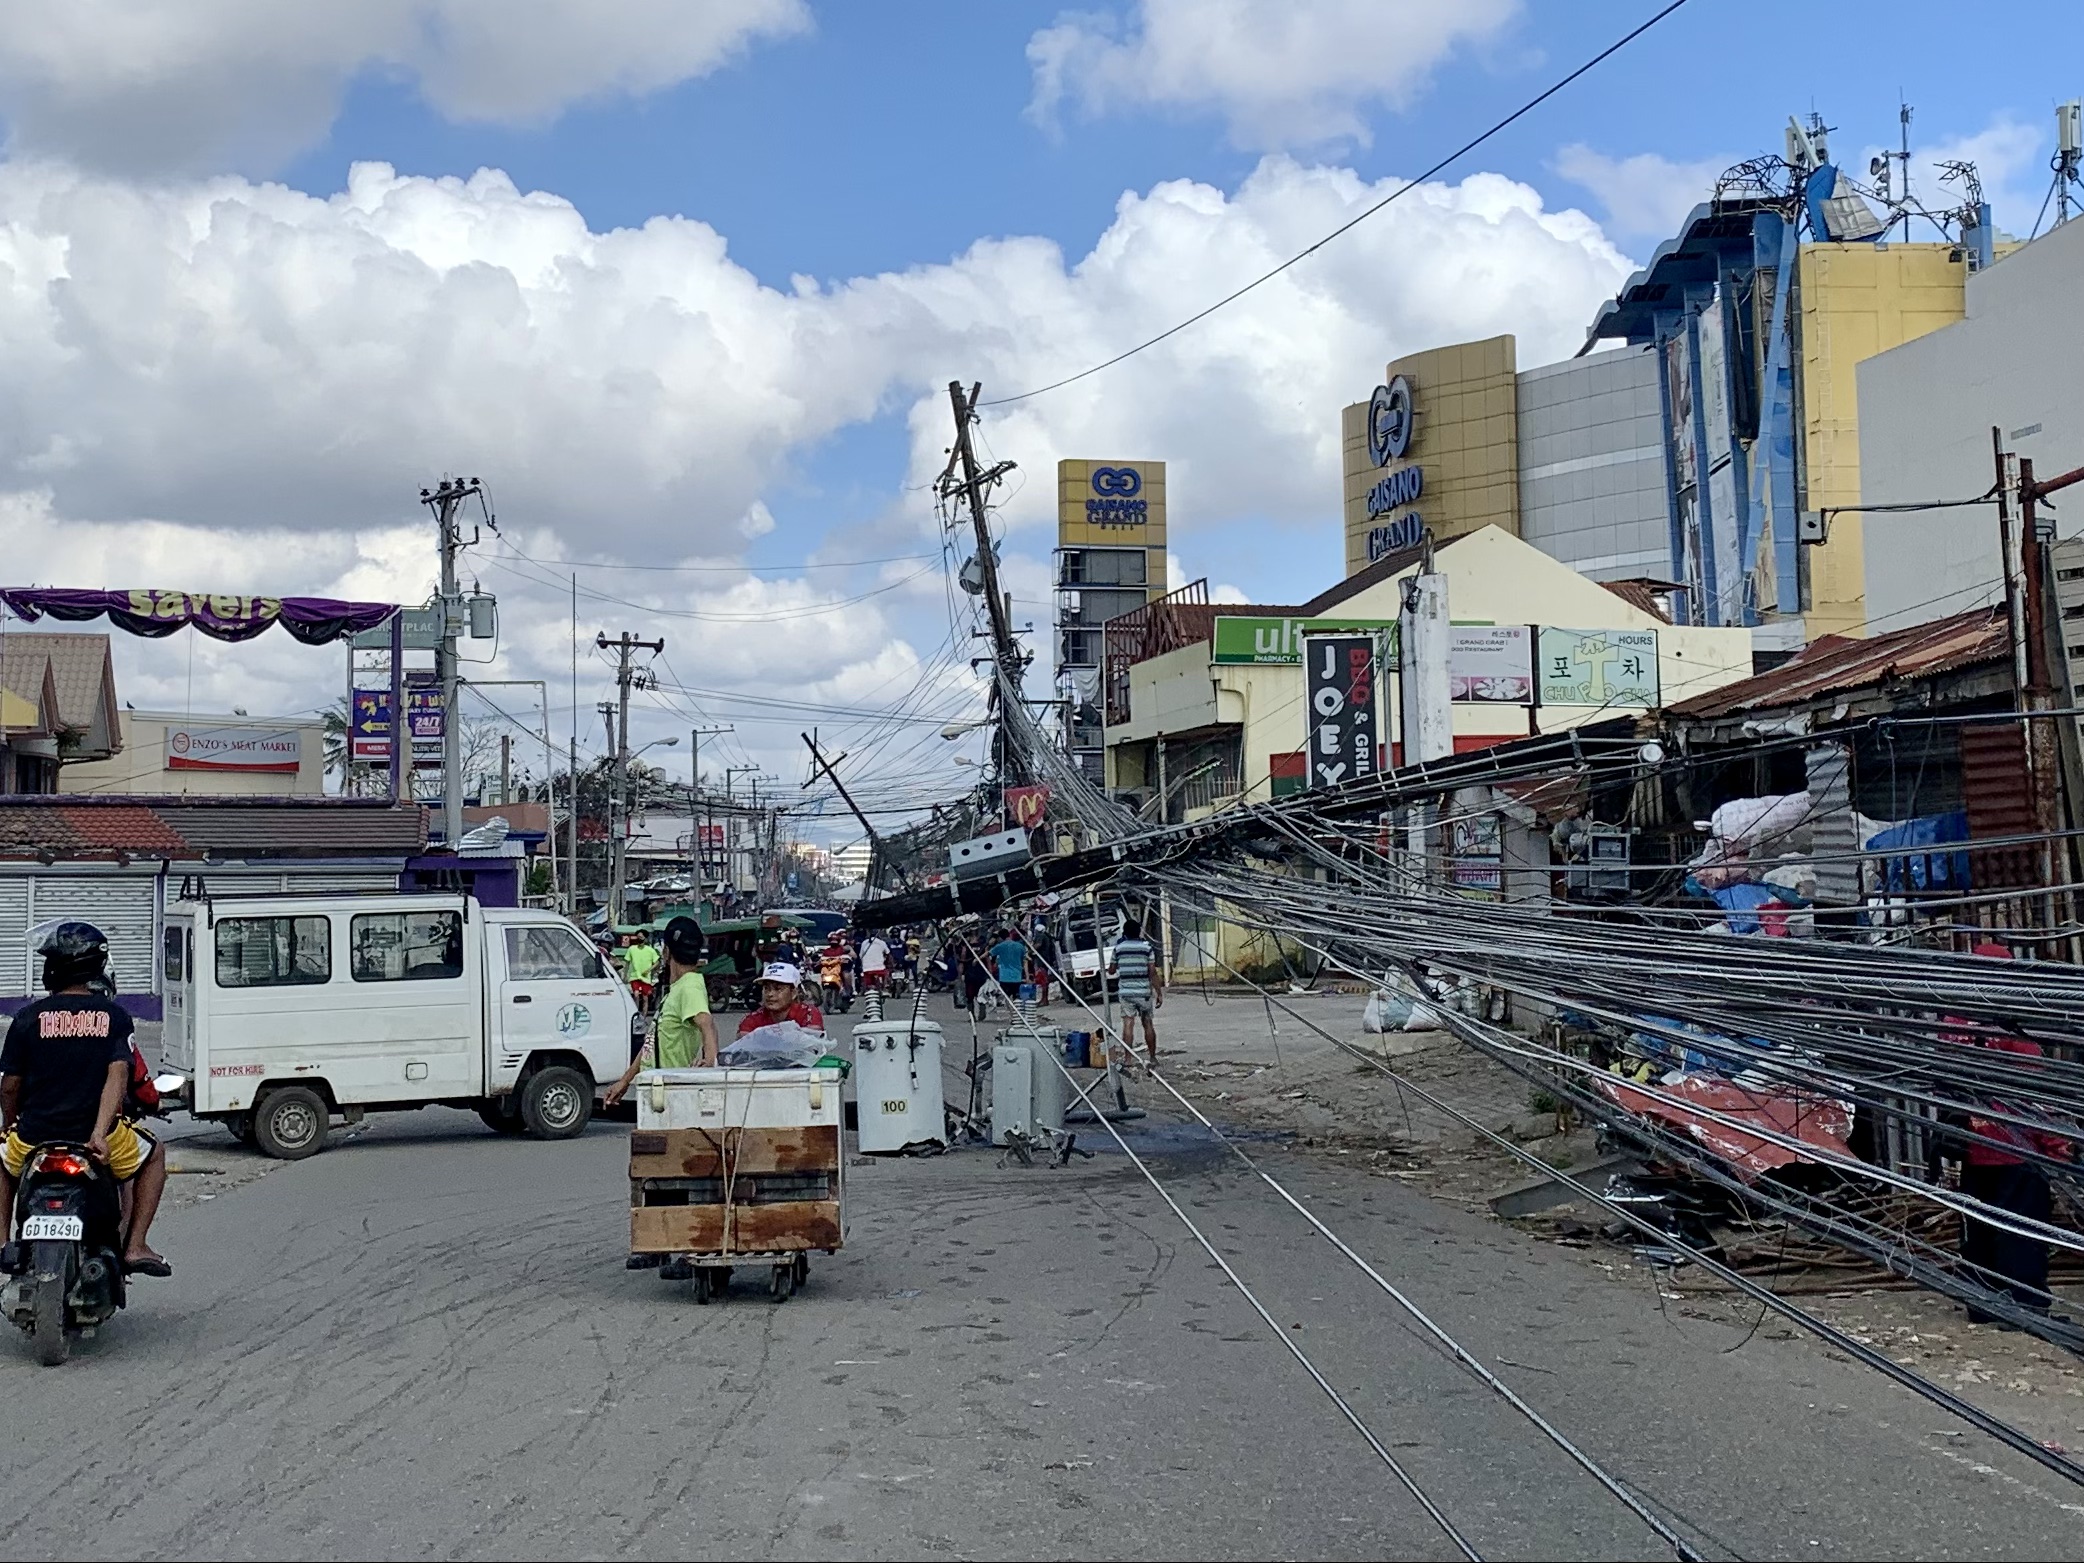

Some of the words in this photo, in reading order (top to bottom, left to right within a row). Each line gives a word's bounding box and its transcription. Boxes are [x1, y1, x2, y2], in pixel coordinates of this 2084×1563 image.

[1367, 465, 1423, 520] GAISANO
[1368, 511, 1424, 563] GRAND
[1619, 635, 1653, 645] HOURS
[1254, 655, 1290, 663] PHARMACY
[1549, 656, 1571, 679] 포
[1620, 655, 1645, 682] 차
[1544, 686, 1576, 701] CHU
[415, 717, 440, 728] 24/7
[192, 739, 228, 750] ENZO'S
[231, 740, 257, 751] MEAT
[261, 741, 297, 752] MARKET
[211, 1067, 226, 1076] NOT
[228, 1066, 244, 1075] FOR
[883, 1100, 906, 1112] 100
[25, 1224, 40, 1237] GD
[44, 1222, 80, 1237] 18490
